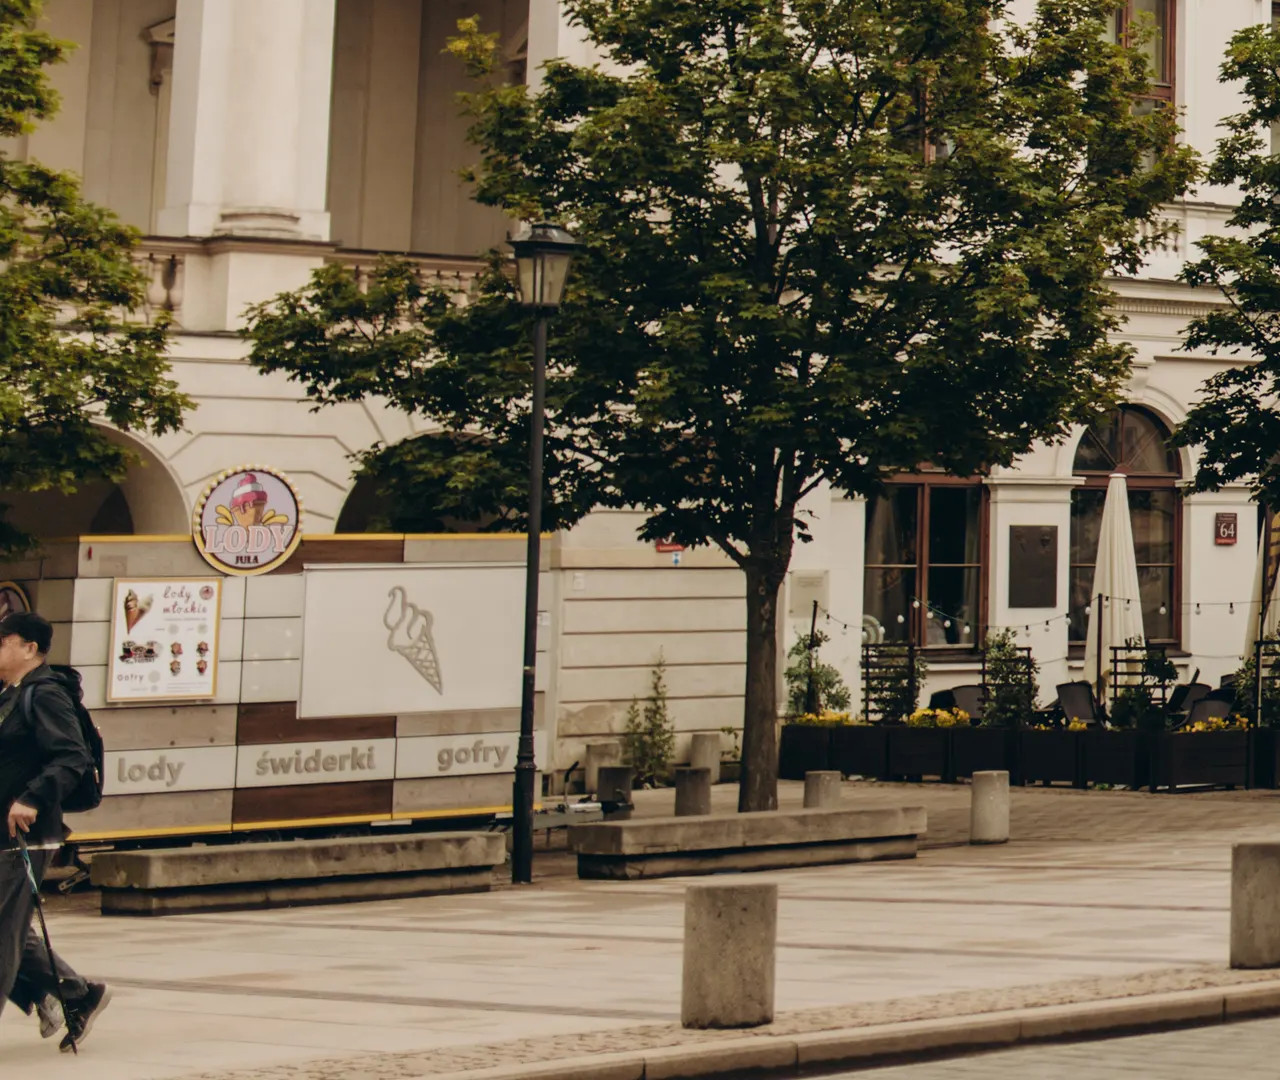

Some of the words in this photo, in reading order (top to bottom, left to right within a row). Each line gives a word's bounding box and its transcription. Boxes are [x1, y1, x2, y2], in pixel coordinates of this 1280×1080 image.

[204, 525, 294, 554] LODY
[1220, 522, 1235, 538] 64
[234, 555, 260, 565] JULA
[163, 585, 192, 604] lody
[255, 745, 376, 776] świderki
[437, 739, 510, 772] gofry
[117, 755, 185, 787] lody
